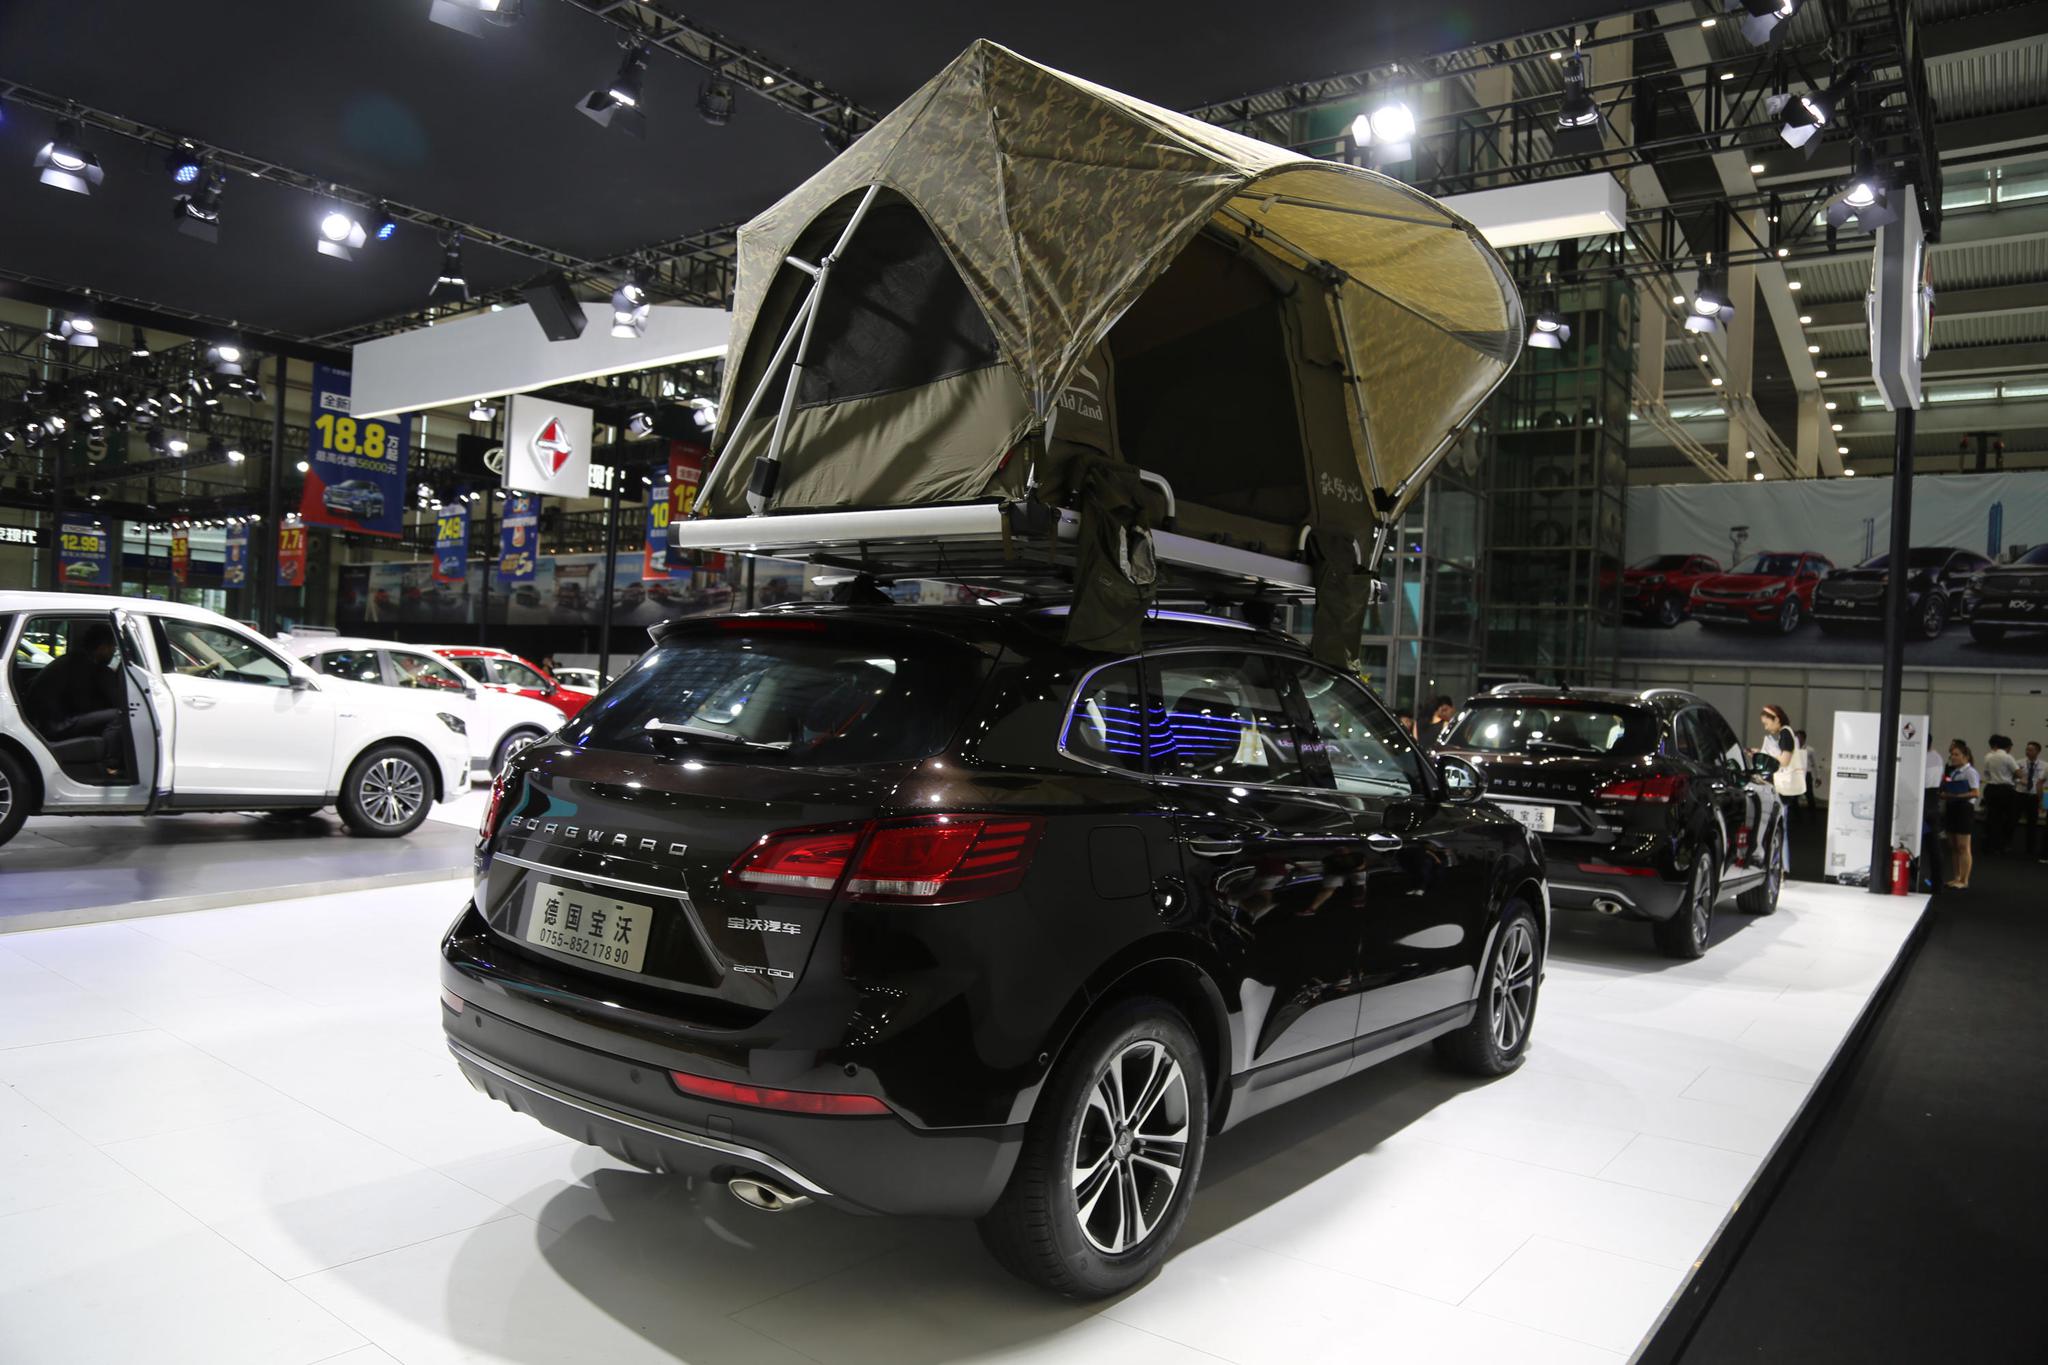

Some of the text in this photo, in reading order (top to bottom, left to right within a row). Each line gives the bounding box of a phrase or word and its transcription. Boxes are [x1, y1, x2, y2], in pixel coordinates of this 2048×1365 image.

[323, 393, 351, 412] 全新
[1077, 397, 1103, 421] Land
[315, 413, 386, 459] 18.8
[1505, 808, 1546, 824] 国宝沃
[510, 815, 689, 857] BORGWARD
[543, 898, 633, 945] 德国宝沃
[727, 916, 801, 935] 宝沃汽车
